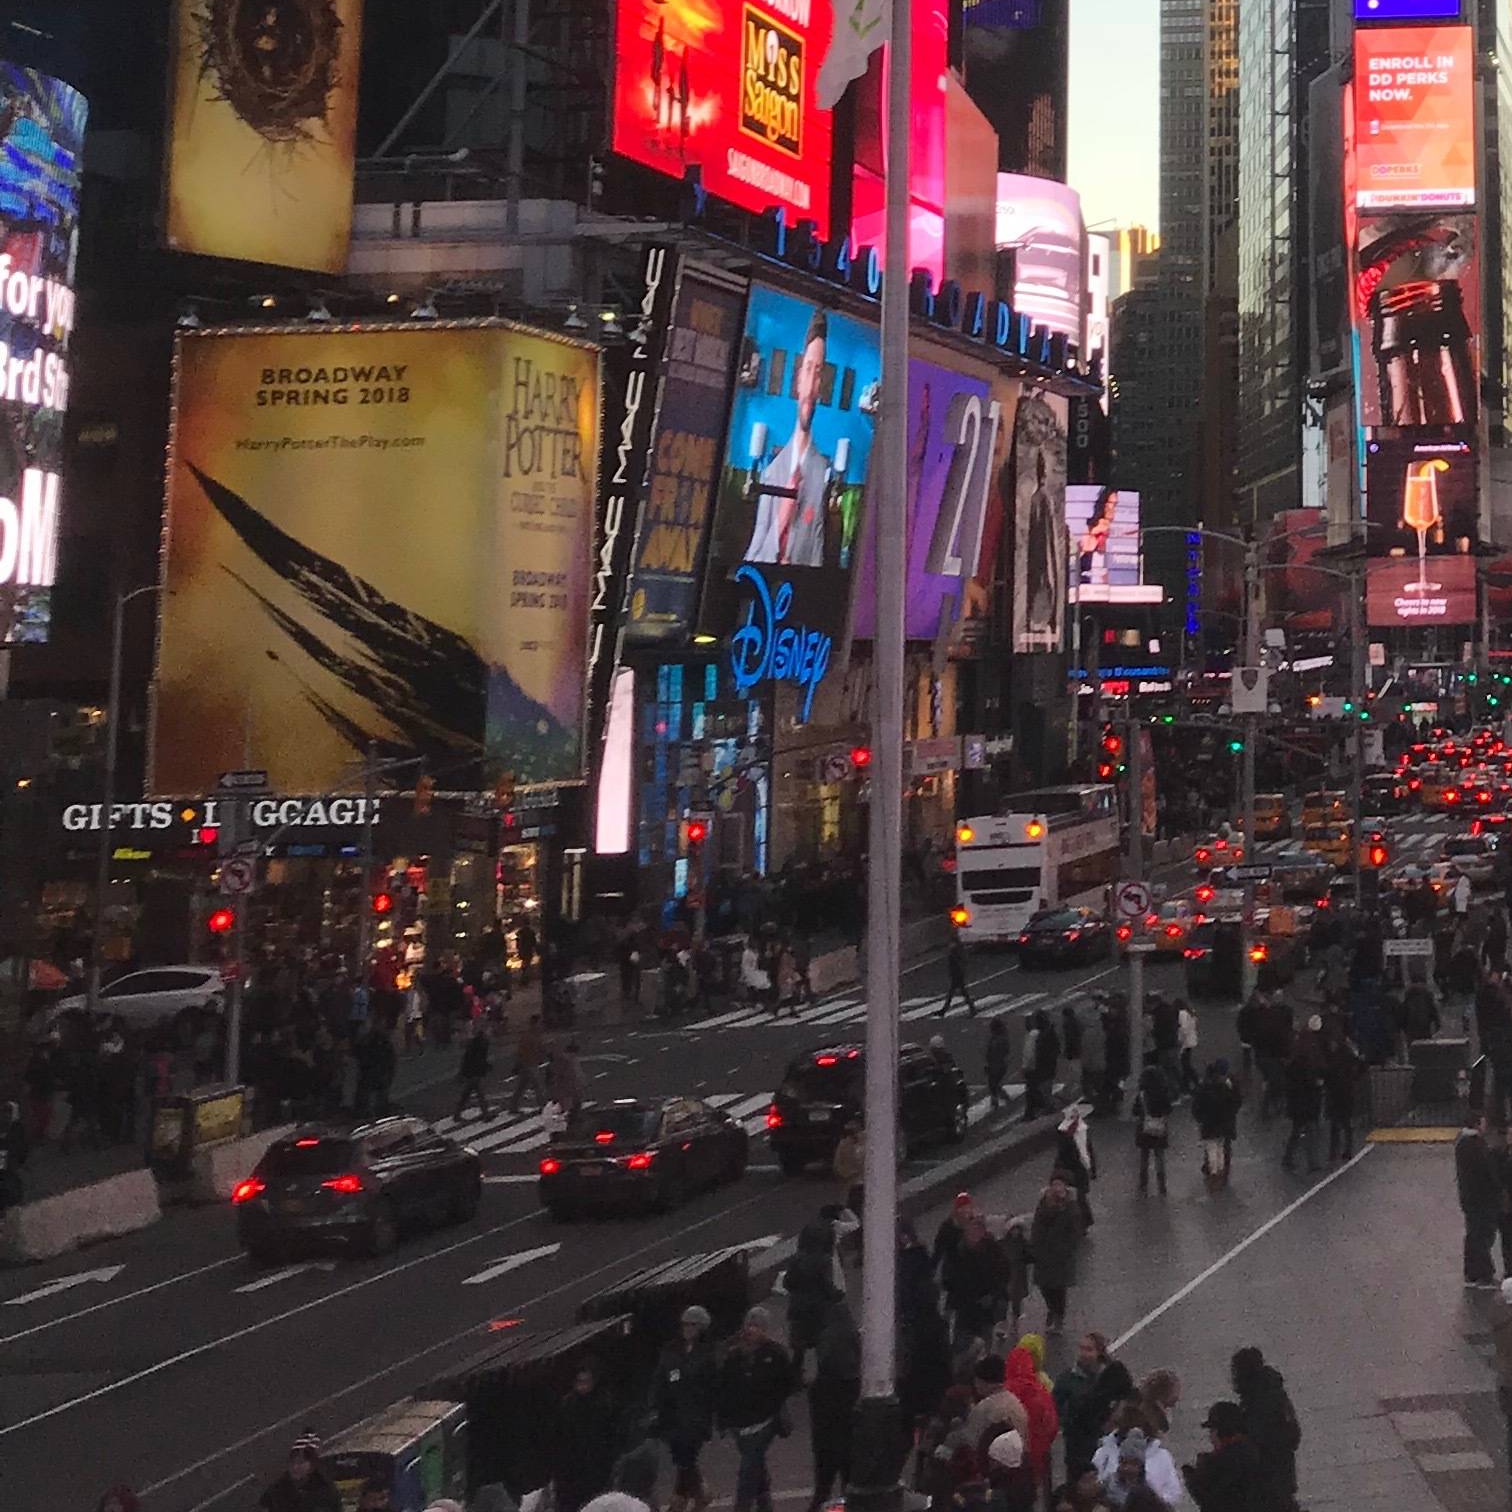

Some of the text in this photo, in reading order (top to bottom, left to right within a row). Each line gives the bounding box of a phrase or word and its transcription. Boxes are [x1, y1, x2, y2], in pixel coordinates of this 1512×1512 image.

[1369, 56, 1454, 71] ENROLL IN
[1369, 72, 1448, 86] DD PERKS
[1369, 89, 1413, 101] NOW.
[744, 69, 799, 142] Saigon
[261, 365, 409, 385] BROADWAY
[256, 388, 411, 407] SPRING 2018
[234, 435, 426, 452] HarryPotterThePlay.com
[504, 412, 592, 486] POTTER
[941, 394, 1000, 578] 21
[731, 565, 832, 724] Disney
[62, 798, 380, 831] GIFTS LGGAGE
